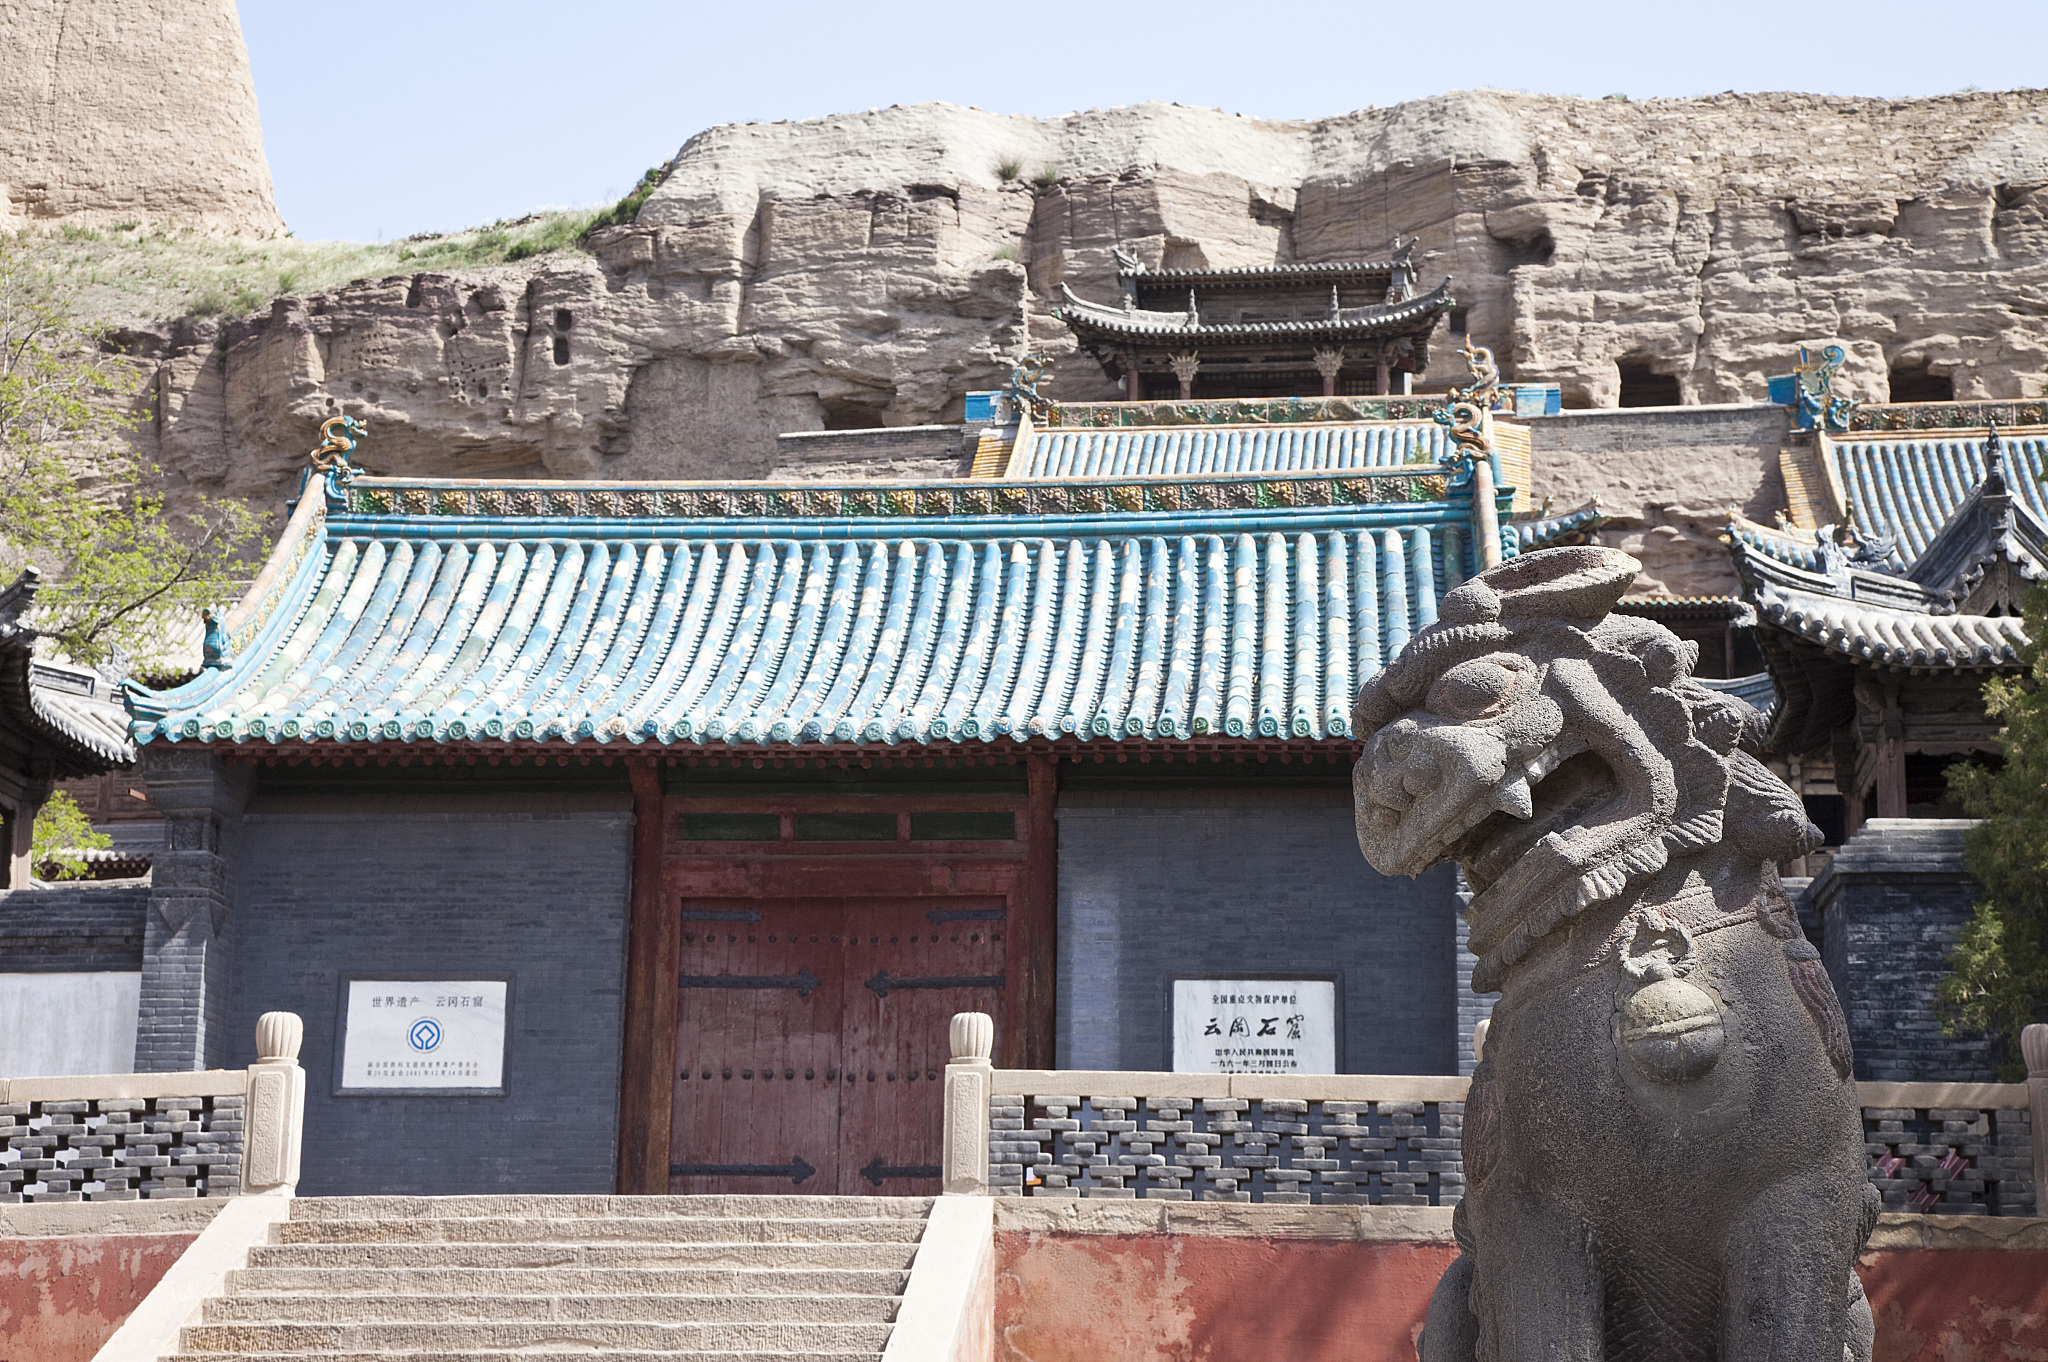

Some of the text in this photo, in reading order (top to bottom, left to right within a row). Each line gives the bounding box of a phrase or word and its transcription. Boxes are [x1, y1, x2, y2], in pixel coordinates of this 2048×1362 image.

[372, 996, 484, 1008] 世界遗产 云冈石窟
[1212, 994, 1298, 1005] 全国重点文物保护单位
[1214, 1048, 1295, 1057] 中华人民共和国国务院
[1210, 1059, 1298, 1068] 一九六一年三月四日公布
